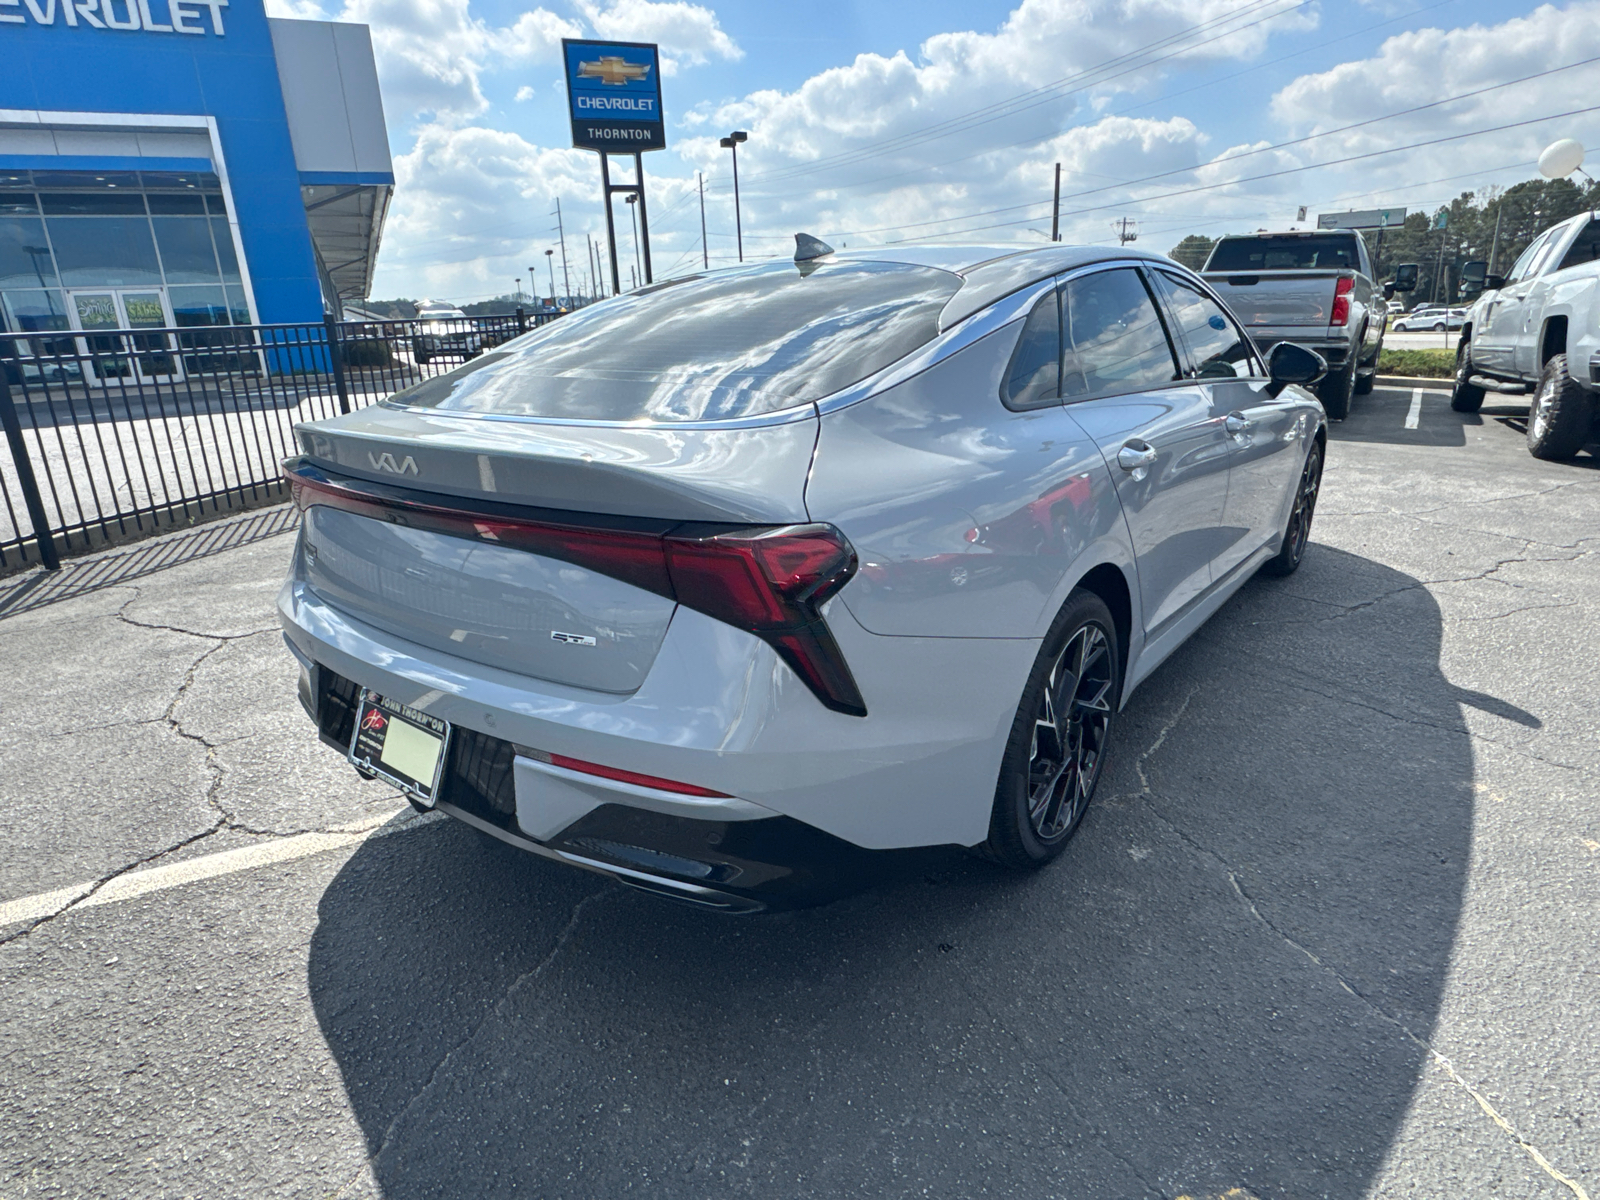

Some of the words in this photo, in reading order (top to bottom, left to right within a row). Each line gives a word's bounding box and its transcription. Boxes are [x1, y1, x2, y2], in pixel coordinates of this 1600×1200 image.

[577, 96, 653, 111] CHEVROLET
[587, 128, 652, 140] THORNTON
[367, 451, 419, 476] KIA
[380, 696, 402, 713] JOHN
